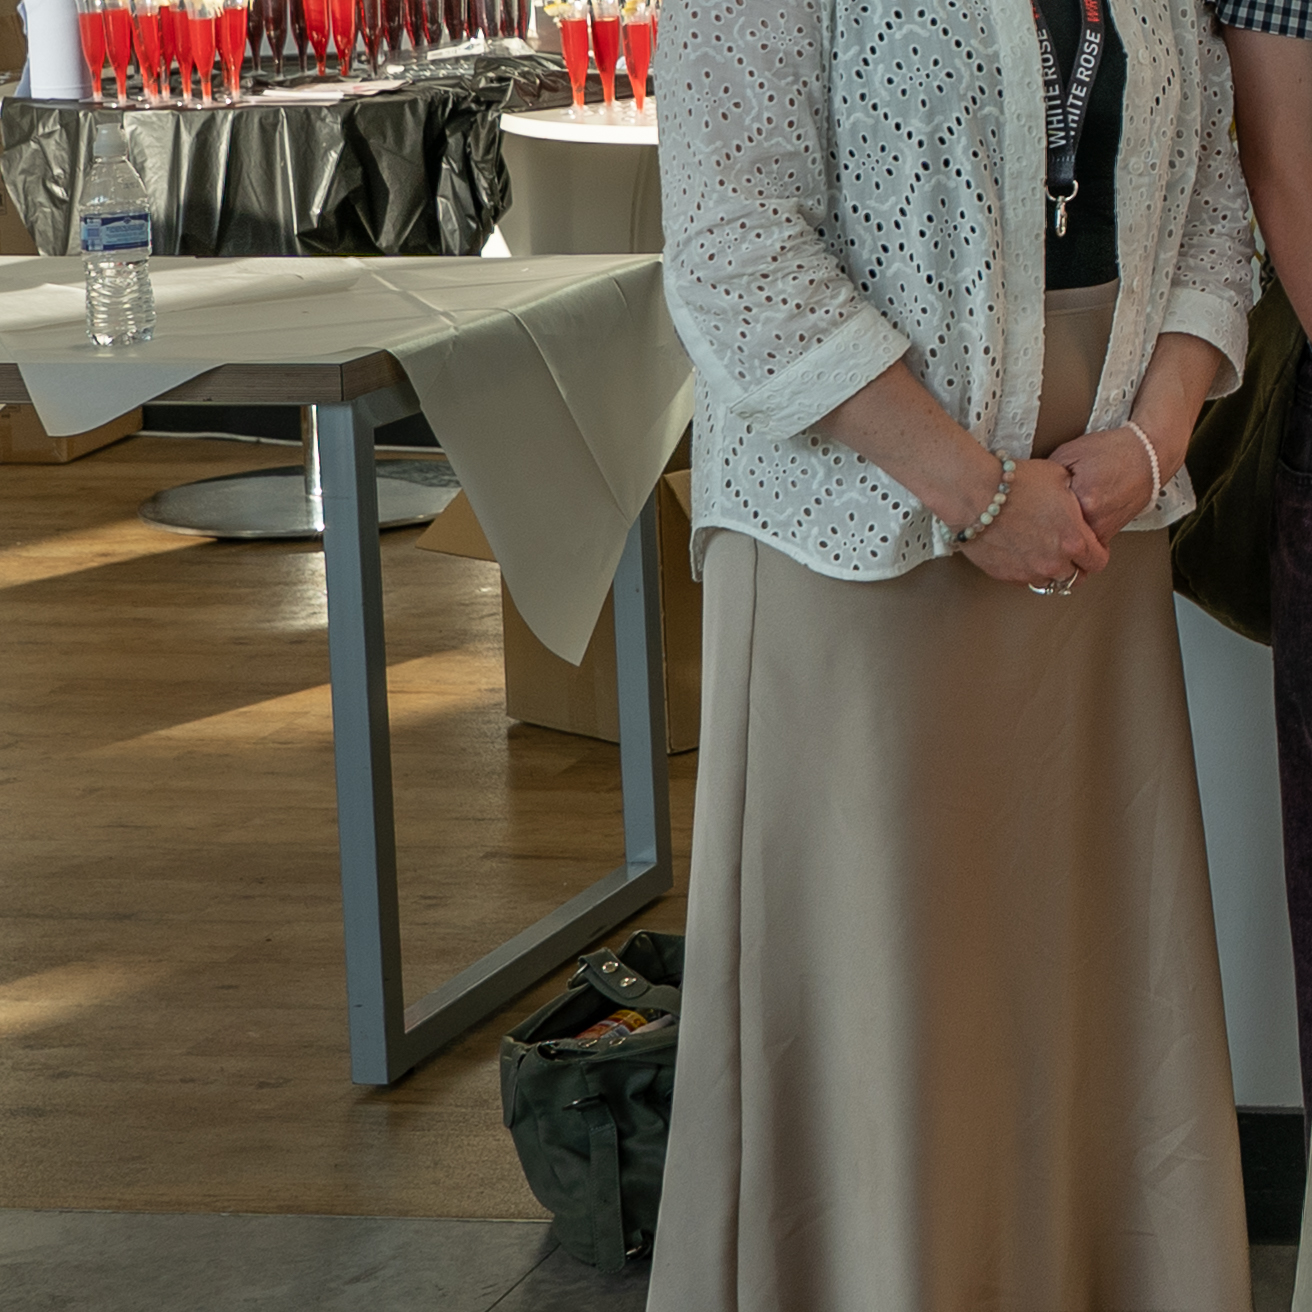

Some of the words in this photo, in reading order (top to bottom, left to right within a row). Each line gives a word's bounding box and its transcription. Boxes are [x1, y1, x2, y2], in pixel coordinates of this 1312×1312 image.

[1036, 28, 1058, 80] ROSE
[1076, 29, 1101, 82] ROSE
[1044, 83, 1067, 149] WHITE
